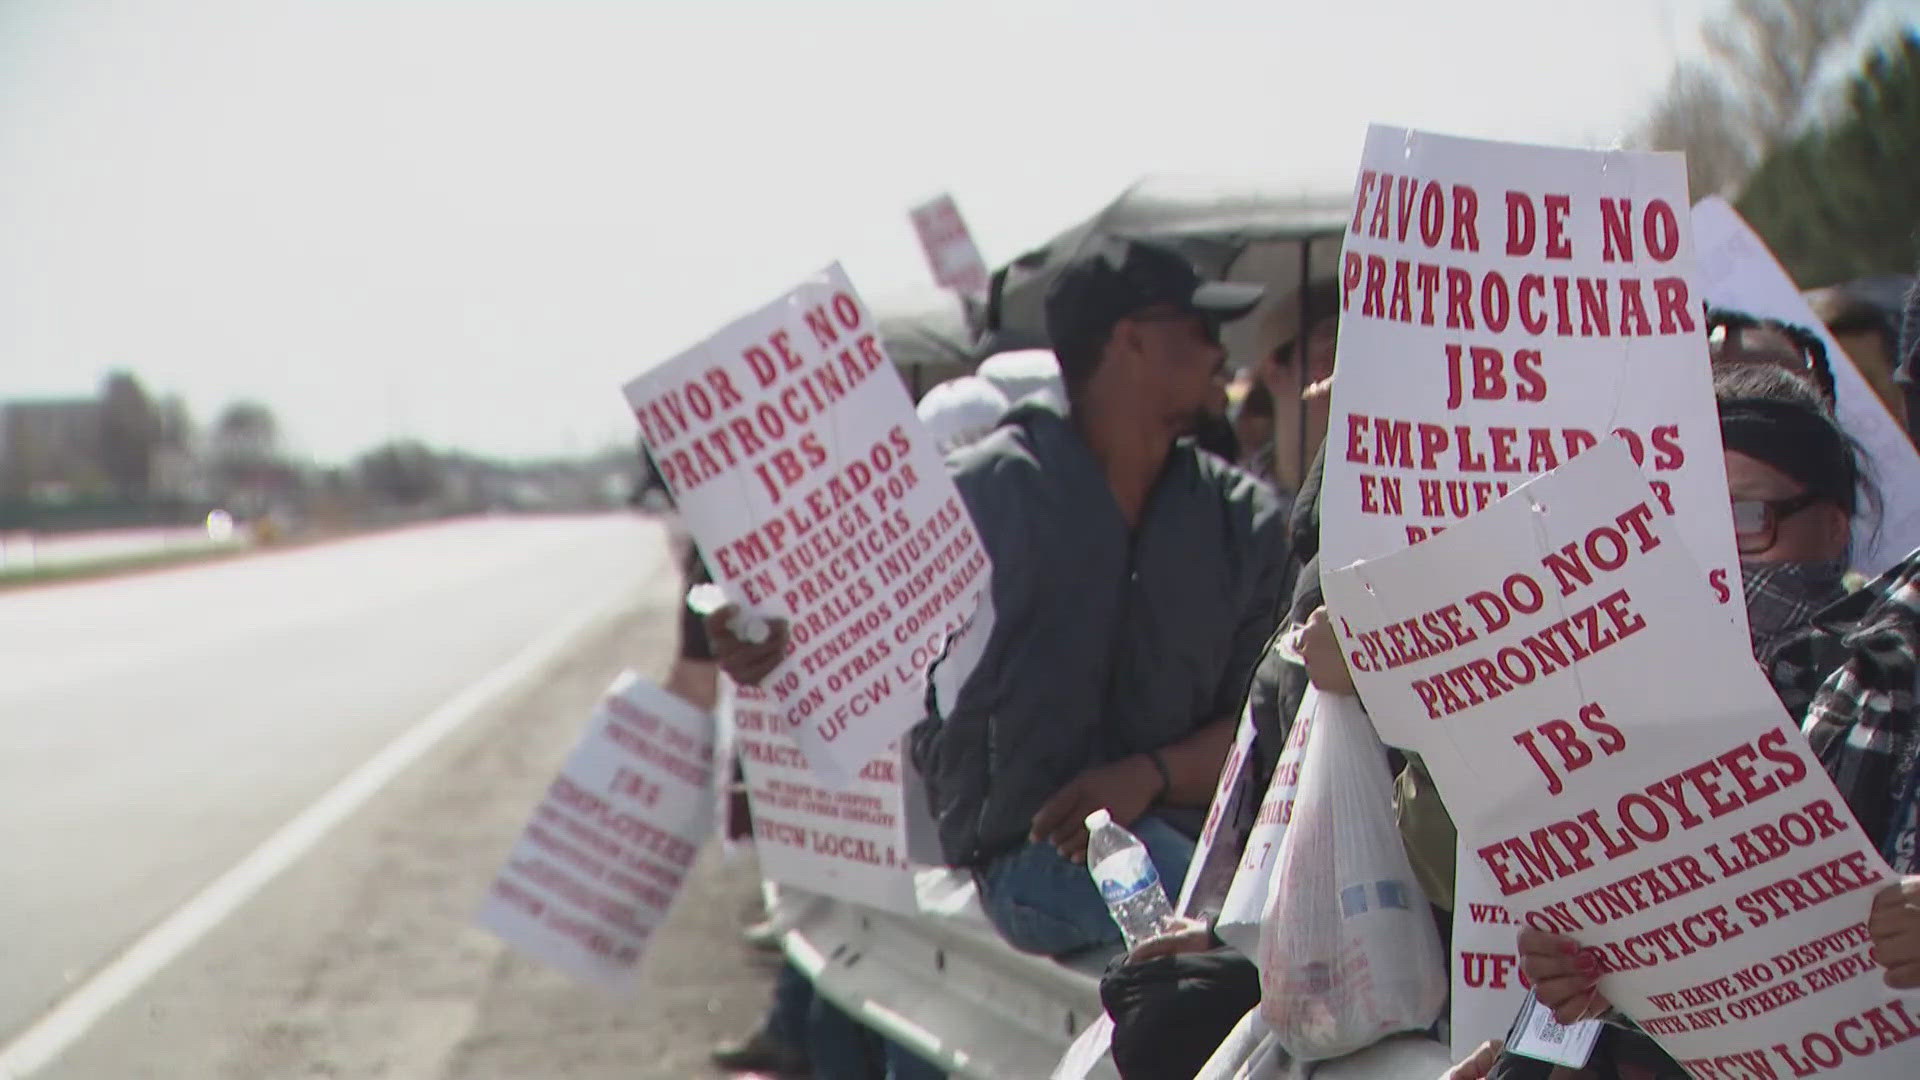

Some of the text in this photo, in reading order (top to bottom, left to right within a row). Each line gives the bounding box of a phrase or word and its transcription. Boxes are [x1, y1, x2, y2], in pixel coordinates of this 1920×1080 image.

[1350, 169, 1680, 264] FAVOR DE NO
[1343, 249, 1696, 338] PRATROCINAR
[637, 291, 861, 449] FAVOR DE NO
[659, 332, 883, 497] PRATROCINAR
[1445, 343, 1548, 411] JBS
[713, 424, 911, 582] EMPLEADOS
[754, 432, 828, 505] JBS
[1360, 474, 1402, 516] EN
[740, 569, 777, 607] EN
[873, 462, 919, 514] POR
[783, 507, 911, 615] PRACTICAS
[875, 496, 962, 586] INJUSTAS
[771, 526, 973, 702] NO TENEMOS DISPUTAS
[1358, 603, 1478, 672] PLEASE
[1466, 573, 1544, 634] DO
[1541, 502, 1661, 597] NOT
[786, 550, 985, 728] CON OTRAS COMPANIAS
[1411, 589, 1646, 720] PATRONIZE
[817, 674, 891, 742] UFCW
[1513, 702, 1626, 796] JBS
[812, 830, 881, 866] LOCAL
[1478, 727, 1807, 897] EMPLOYEES
[1525, 799, 1848, 935] ON UNFAIR LABOR
[1584, 850, 1883, 974] RACTICE STRIKE
[1647, 992, 1685, 1013] WE
[1678, 977, 1738, 1008] HAVE
[1733, 962, 1775, 992] NO
[1684, 1006, 1728, 1031] ANY
[1726, 979, 1808, 1020] OTHER
[1771, 999, 1920, 1078] LOCAL
